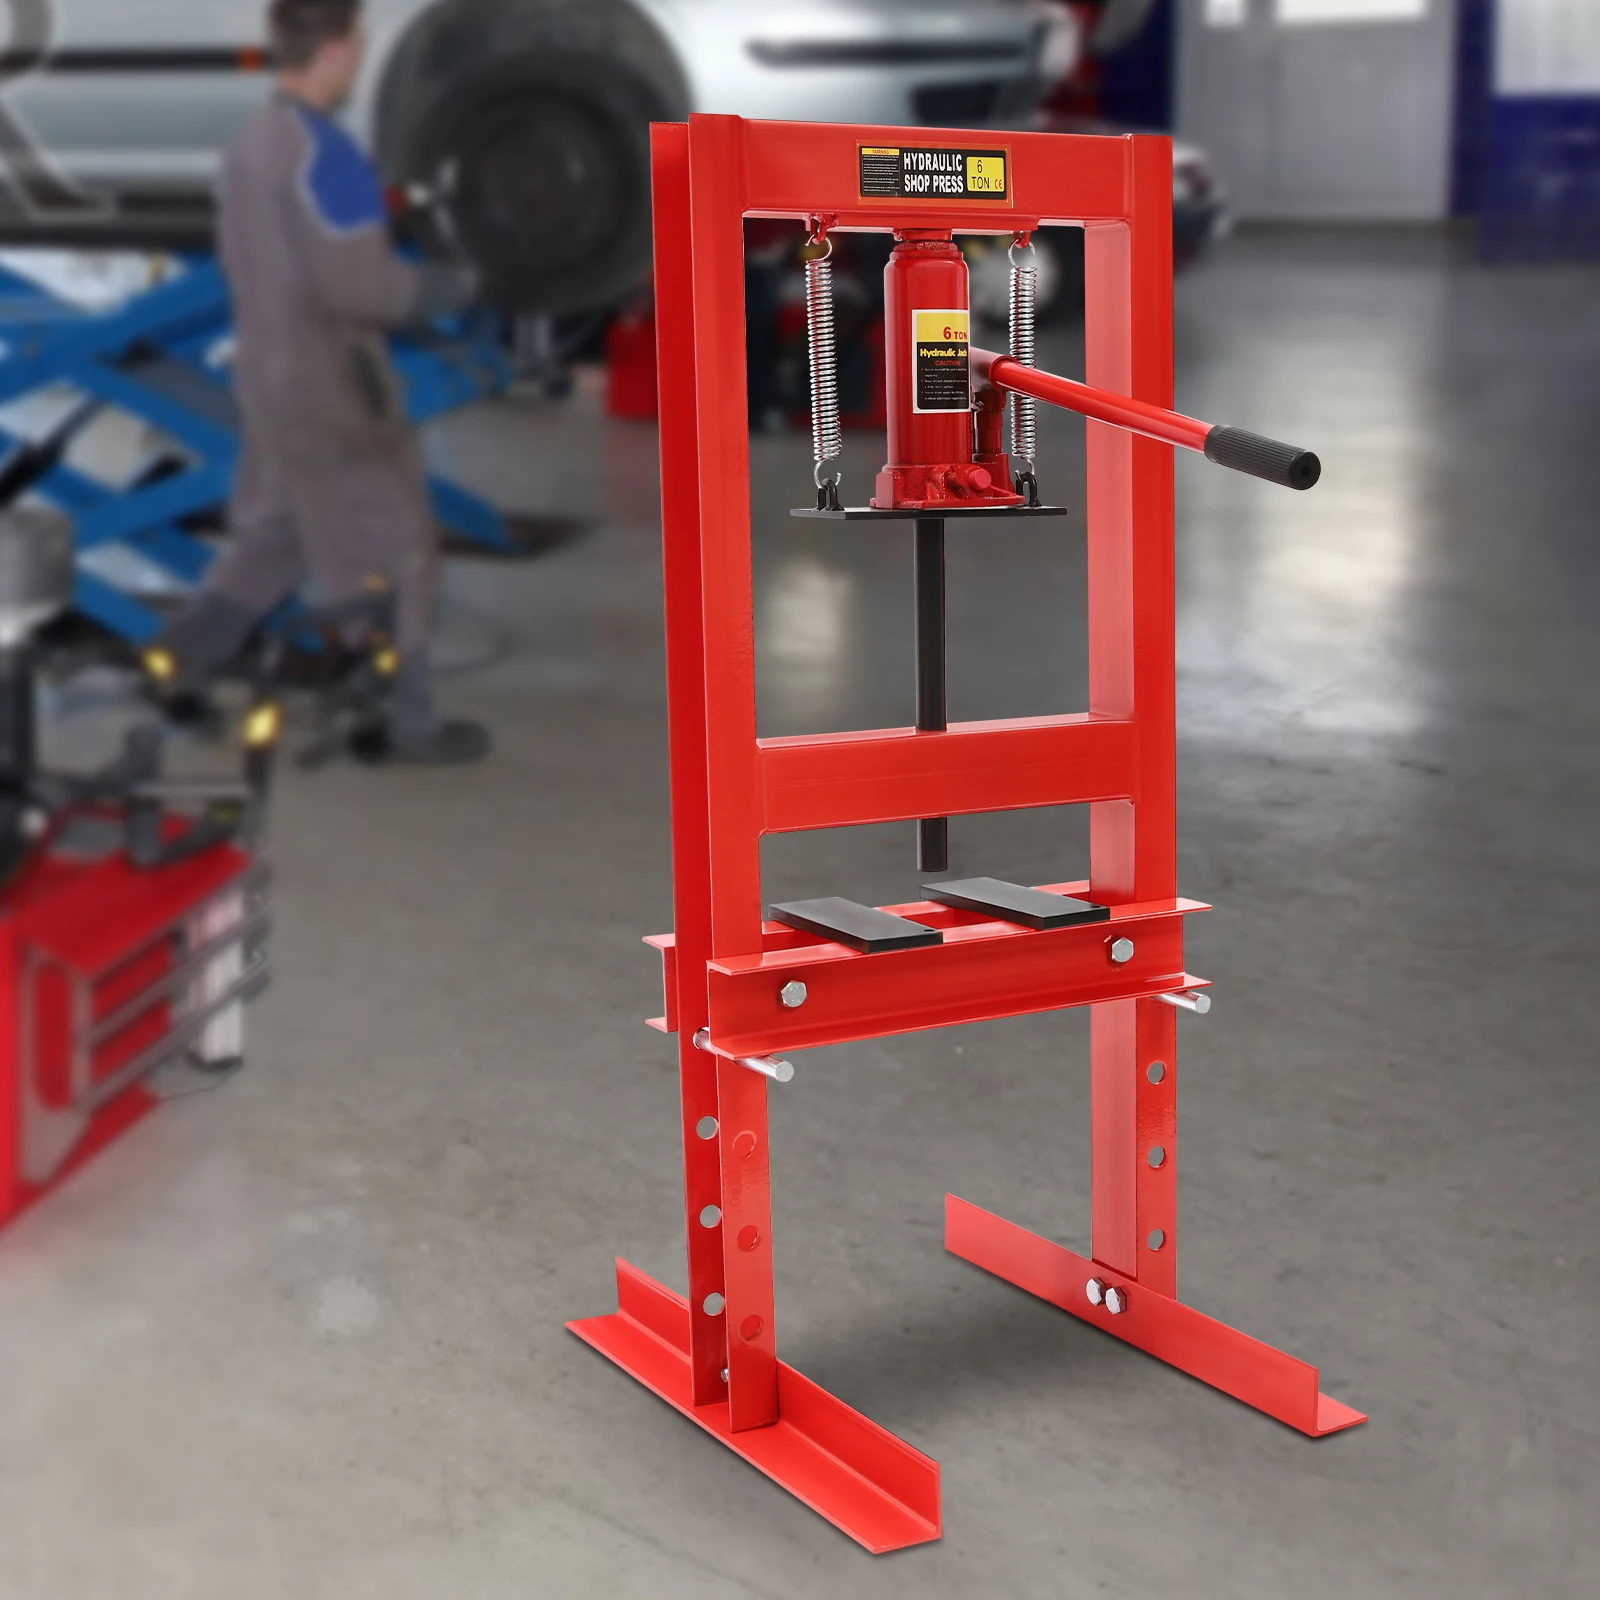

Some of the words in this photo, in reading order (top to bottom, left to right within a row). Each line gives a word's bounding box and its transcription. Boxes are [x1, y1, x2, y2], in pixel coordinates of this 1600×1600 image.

[903, 152, 963, 172] HYDRAULIC
[977, 159, 983, 174] 6
[904, 174, 930, 192] SHOP
[933, 175, 964, 193] PRESS
[971, 176, 990, 190] TON
[943, 326, 952, 340] 6
[953, 331, 968, 340] TON
[920, 348, 956, 358] Hydraulic
